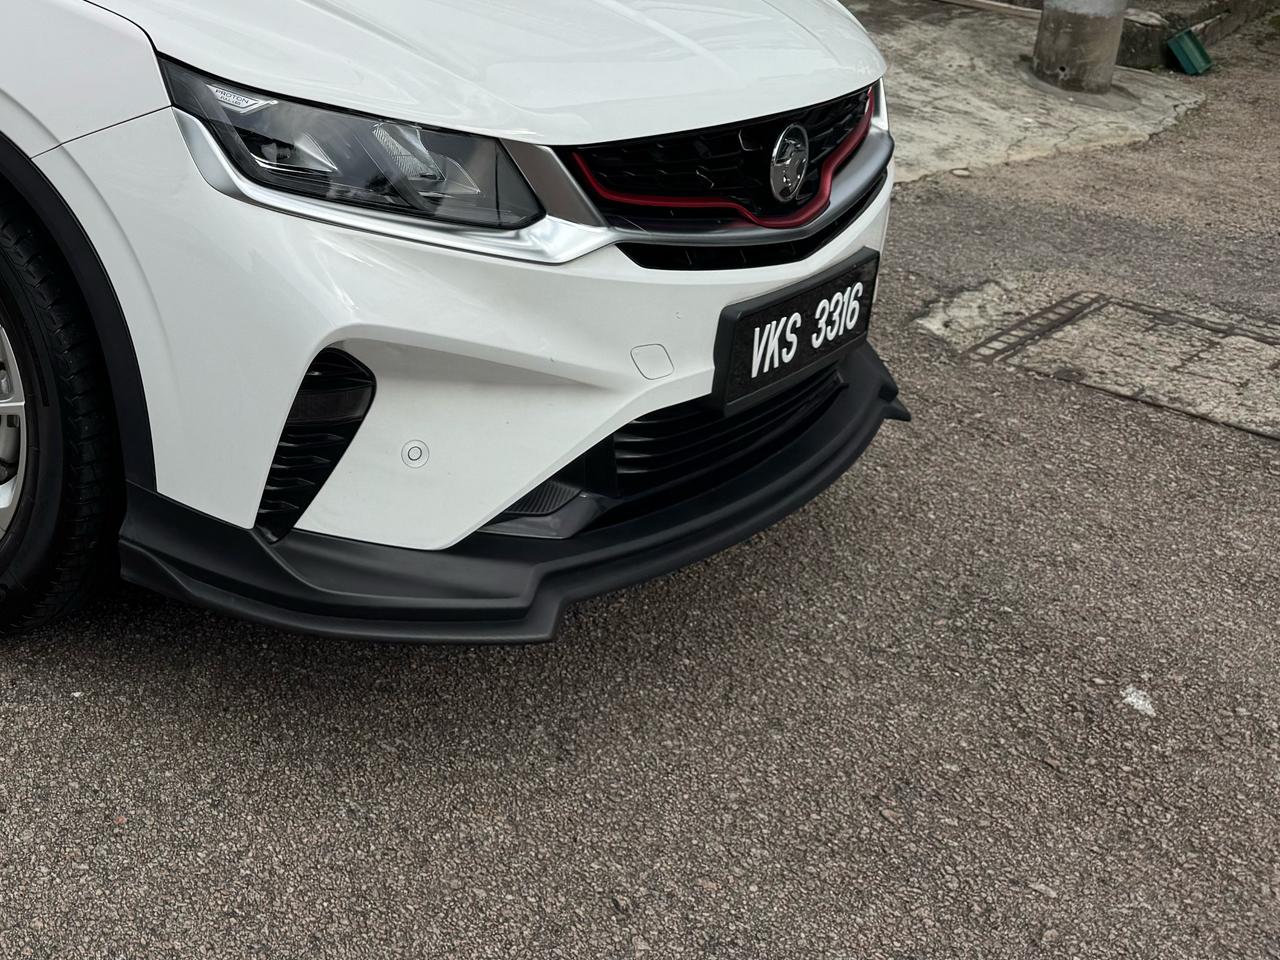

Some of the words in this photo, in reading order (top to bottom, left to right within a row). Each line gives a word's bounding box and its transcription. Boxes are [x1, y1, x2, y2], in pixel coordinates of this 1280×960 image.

[215, 89, 248, 104] PROTON
[751, 312, 801, 378] VKS
[811, 282, 864, 348] 3316
